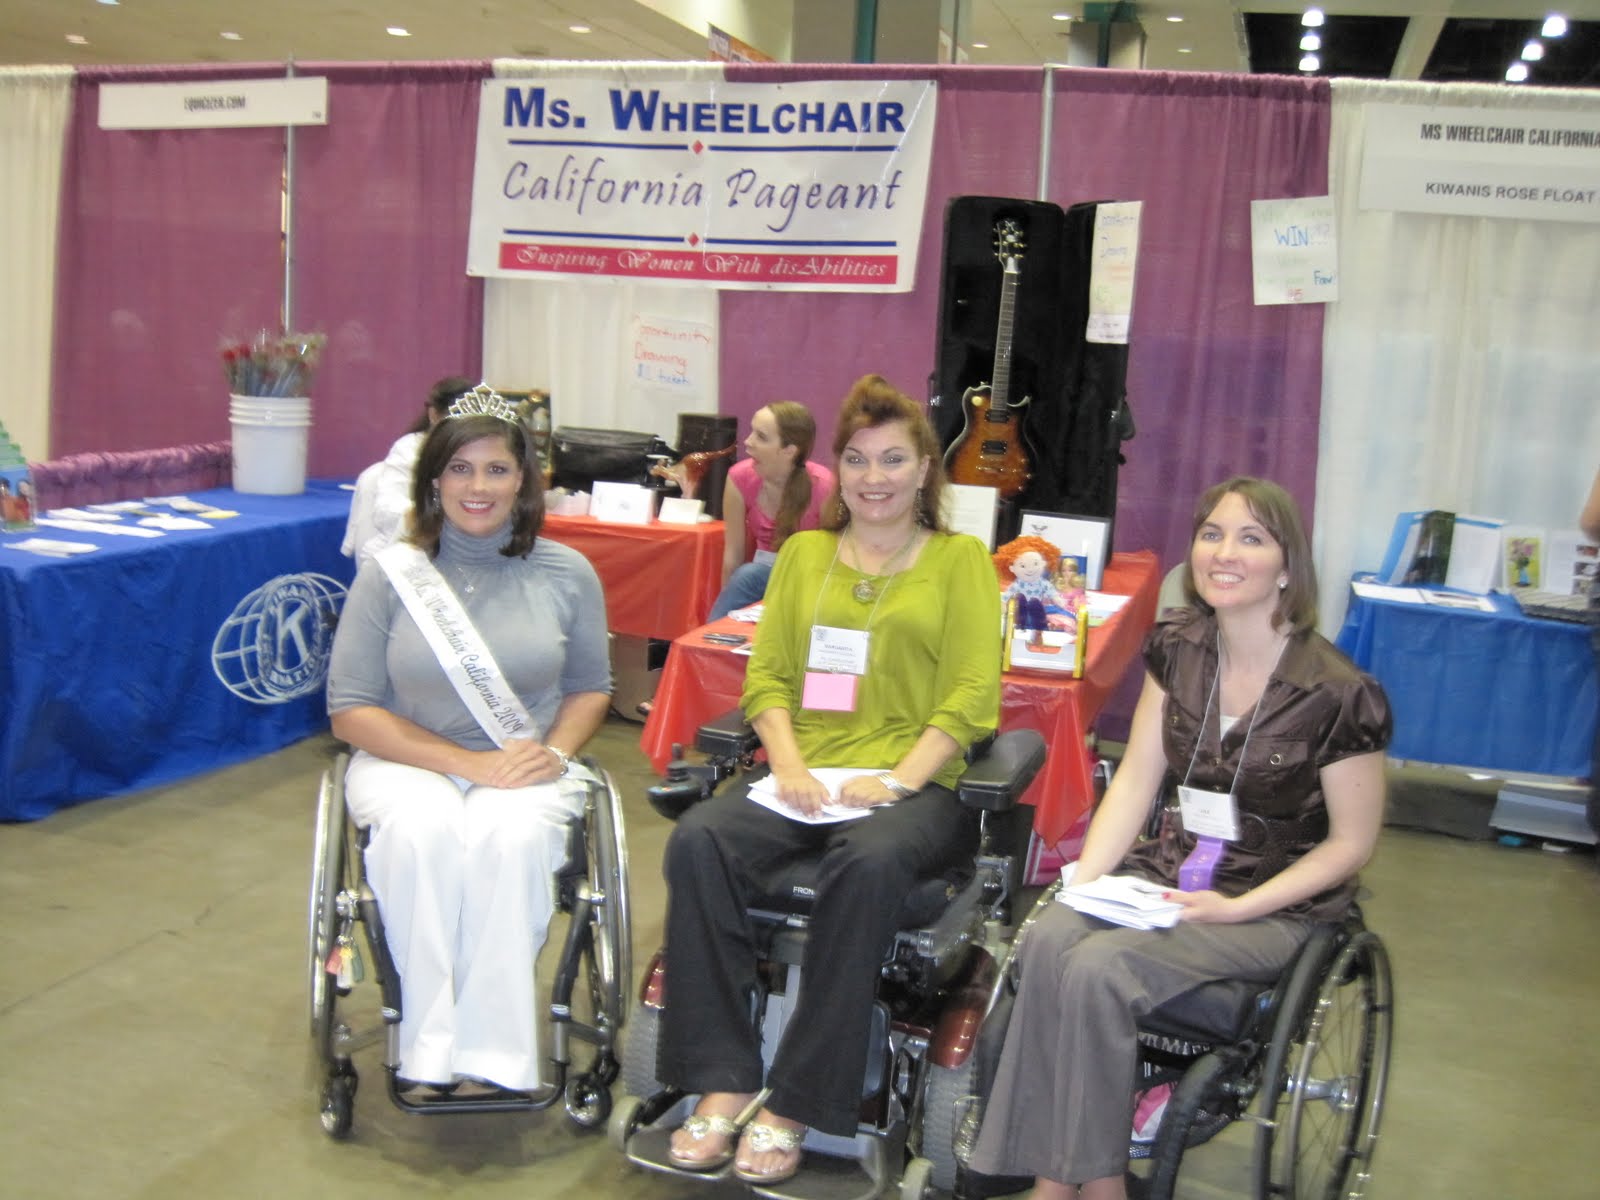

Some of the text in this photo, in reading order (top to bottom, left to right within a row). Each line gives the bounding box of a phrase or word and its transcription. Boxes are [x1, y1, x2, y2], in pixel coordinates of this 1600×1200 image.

[608, 89, 906, 133] WHEELCHAIR
[1420, 123, 1600, 148] MS WHEELCHAIR CALIFORNIA
[502, 155, 901, 232] California Pageant
[1426, 183, 1597, 204] KIWANIS ROSE FLOAT
[1274, 225, 1308, 247] WIN
[517, 245, 608, 272] Inspiring
[617, 249, 695, 272] Women
[705, 254, 761, 274] With
[460, 654, 501, 710] California
[493, 706, 525, 735] 2009
